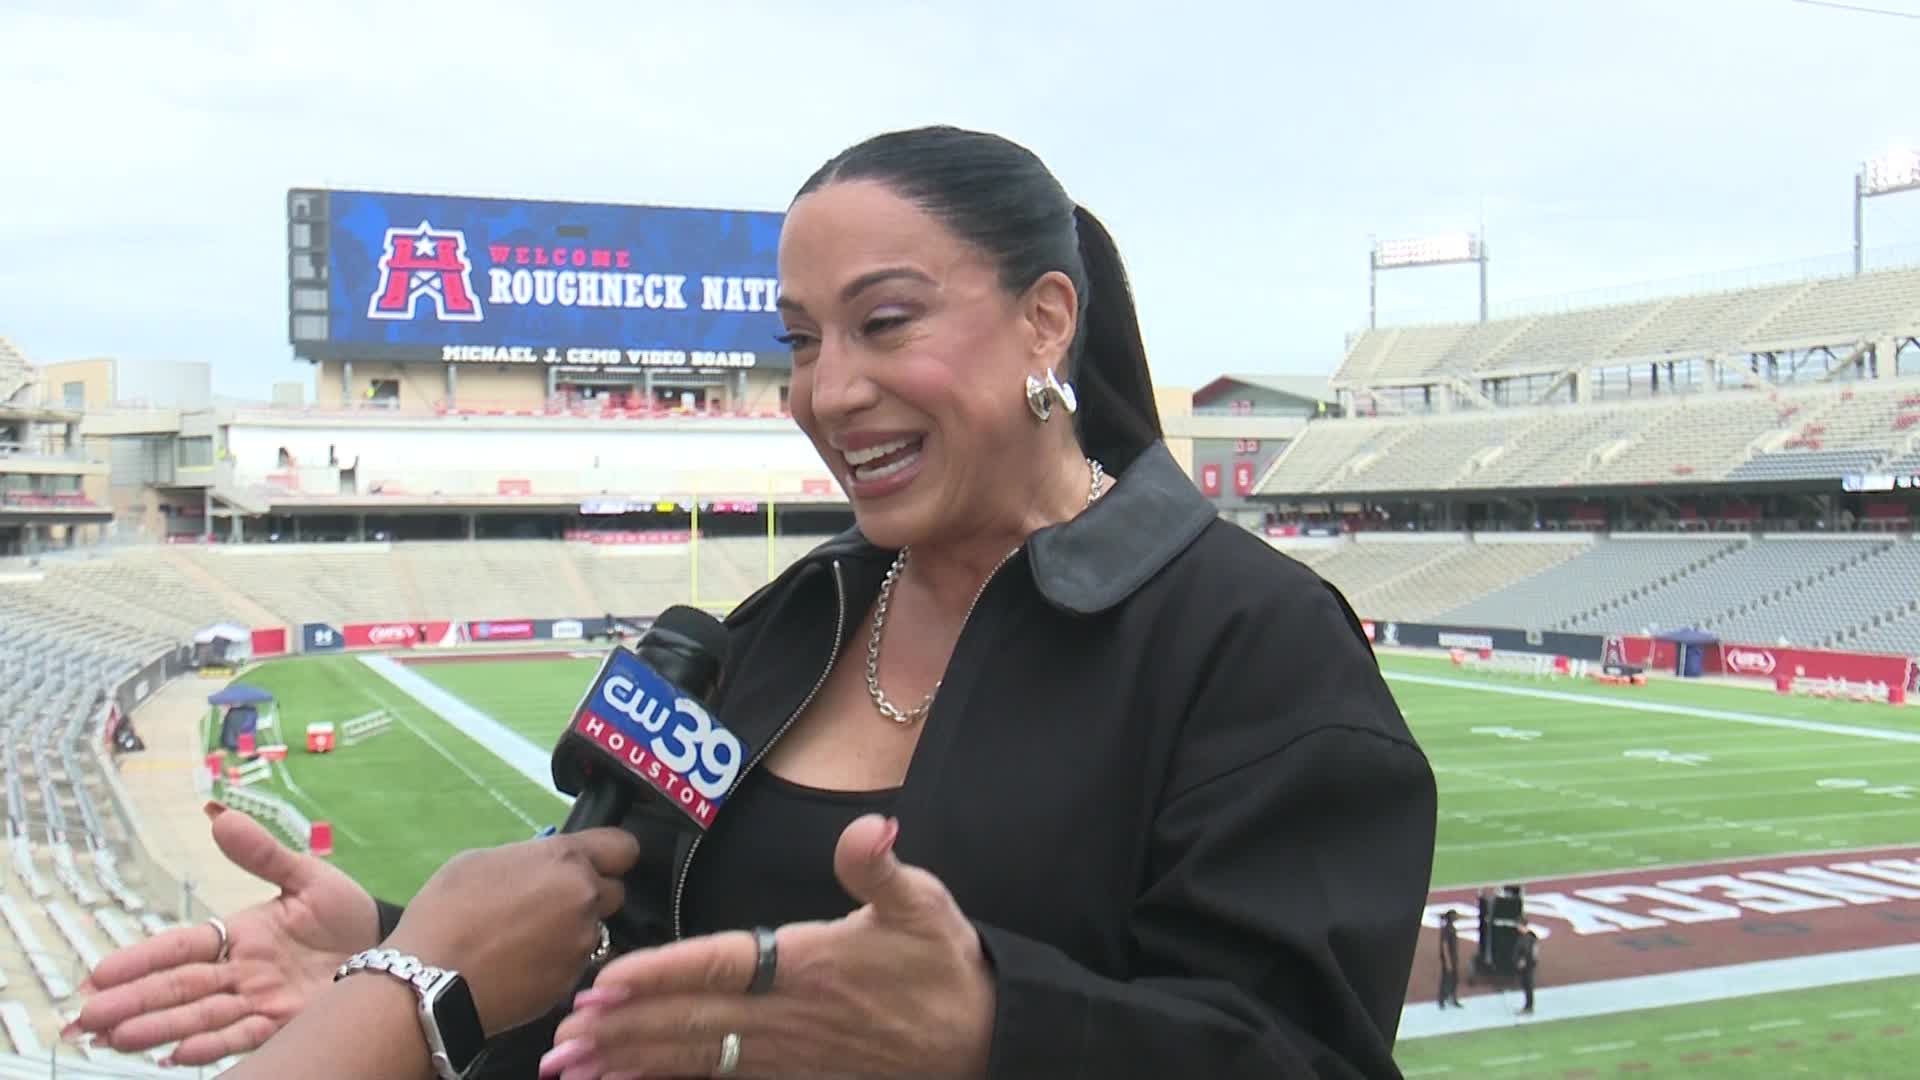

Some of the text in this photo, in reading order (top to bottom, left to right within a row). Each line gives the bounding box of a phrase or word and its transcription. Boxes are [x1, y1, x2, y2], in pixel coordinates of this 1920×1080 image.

[488, 243, 631, 269] WELCOME
[487, 267, 781, 312] ROUGHNECK NATI
[442, 345, 757, 367] MICHAEL J. CEMO VIDEO BOARD
[585, 717, 713, 819] HOUSTON
